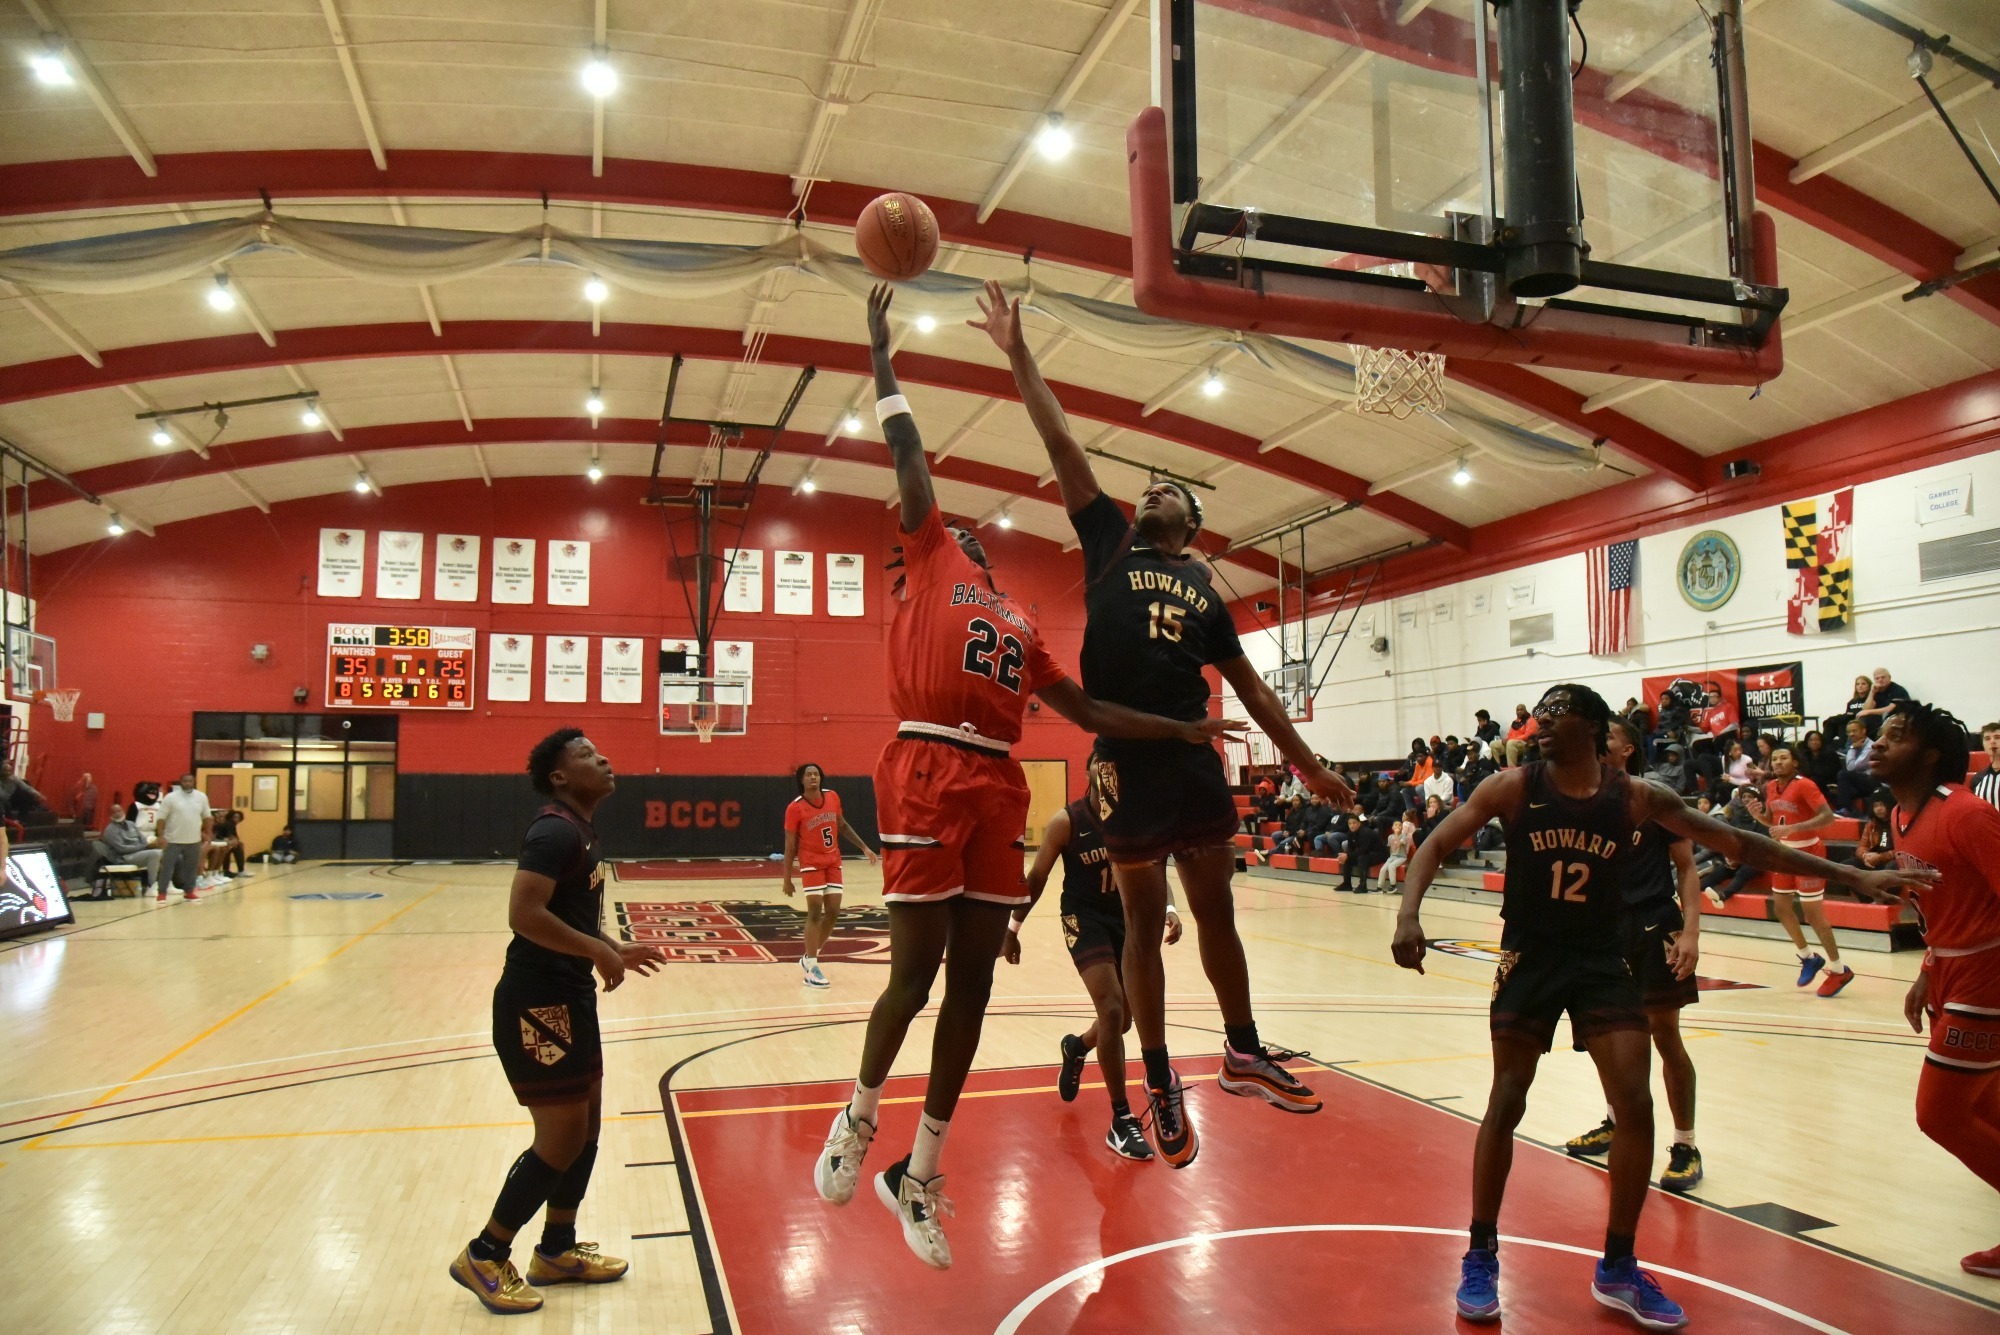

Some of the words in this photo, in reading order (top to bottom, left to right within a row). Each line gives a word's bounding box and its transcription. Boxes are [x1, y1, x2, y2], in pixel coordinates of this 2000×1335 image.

[1928, 488, 1959, 500] GARRETT
[1930, 499, 1959, 511] COLLEGE
[1127, 571, 1209, 613] HOWARD
[1148, 601, 1187, 643] 15
[334, 626, 370, 635] BCCC
[389, 628, 430, 646] 3:58
[332, 647, 376, 656] PANTHERS
[438, 650, 464, 658] GUEST
[962, 617, 1025, 695] 22
[343, 658, 367, 675] 35
[440, 661, 465, 677] 25
[340, 683, 351, 697] 8
[362, 683, 373, 698] 5
[383, 684, 404, 698] 22
[428, 685, 439, 699] 6
[453, 685, 464, 699] 6
[1746, 687, 1794, 705] PROTECT
[1747, 705, 1764, 717] THIS
[645, 800, 741, 828] BCCC
[820, 826, 834, 848] 5
[1529, 828, 1617, 860] HOWARD
[1551, 860, 1590, 903] 12
[1943, 1025, 2000, 1051] BCCC
